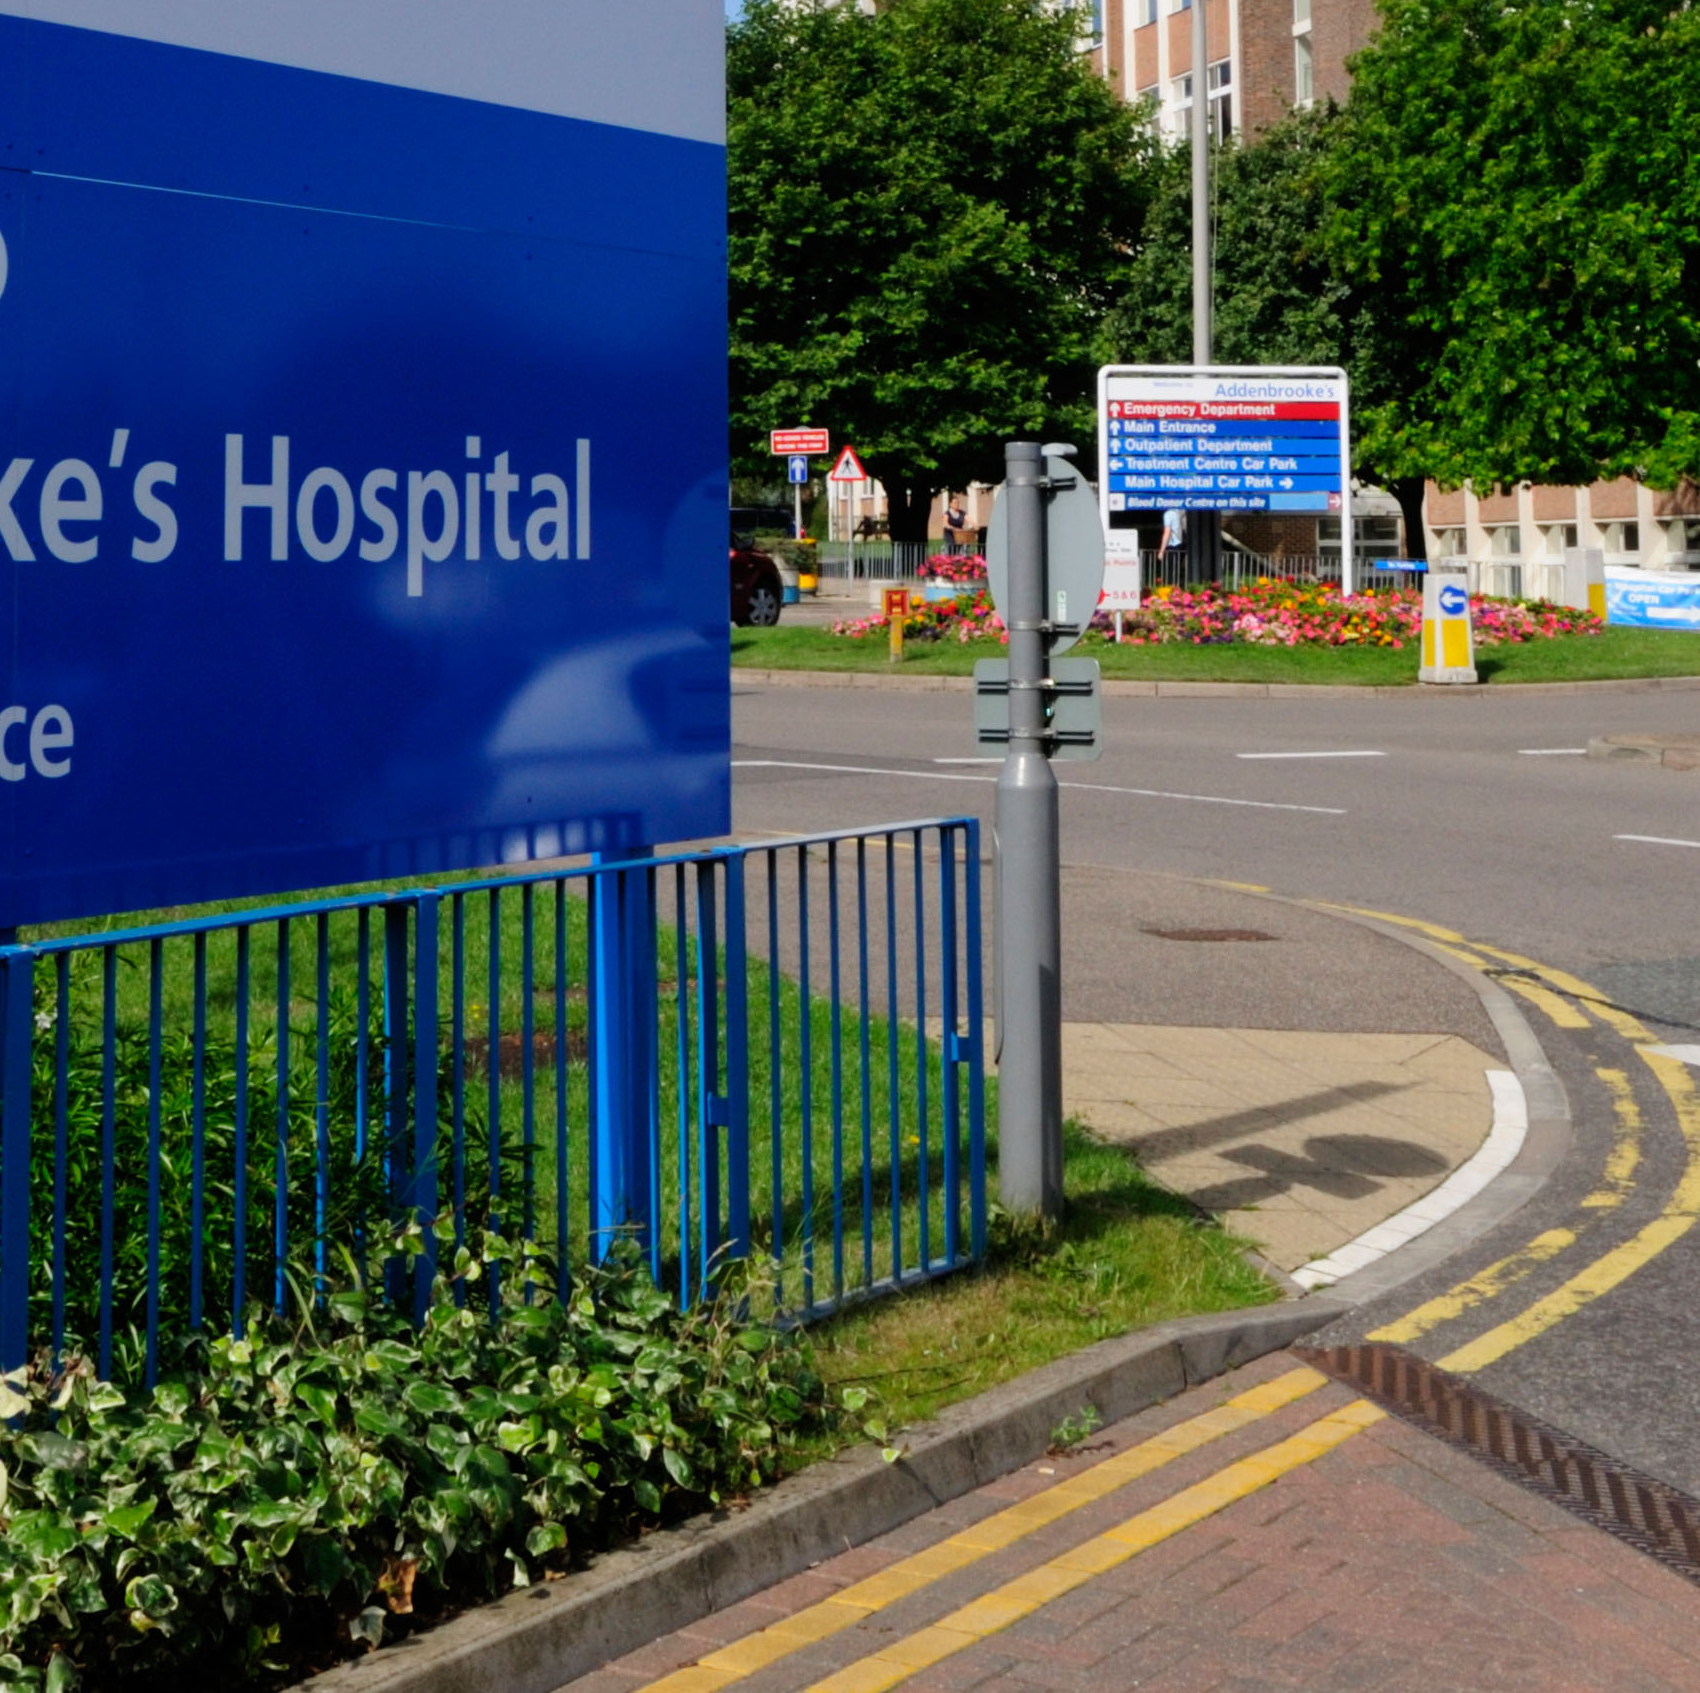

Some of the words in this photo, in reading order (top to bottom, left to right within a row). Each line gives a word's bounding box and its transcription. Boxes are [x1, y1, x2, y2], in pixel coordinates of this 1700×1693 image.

[1214, 382, 1335, 398] Addenbrooke's
[1123, 402, 1197, 417] Emergency
[1200, 403, 1276, 417] Department
[1123, 420, 1155, 433] Main
[1159, 420, 1216, 433] Entrance
[1124, 438, 1194, 453] Outpatient
[1197, 438, 1273, 454] Department
[1124, 456, 1190, 470] Treatment
[1194, 456, 1238, 470] Centre
[1242, 456, 1266, 470] Car
[1269, 457, 1298, 470] Park
[1124, 475, 1156, 488] Main
[1160, 475, 1214, 490] Hospital
[1217, 475, 1241, 488] Car
[1245, 475, 1274, 488] Park
[1185, 497, 1216, 508] Centre
[223, 432, 591, 598] Hospital
